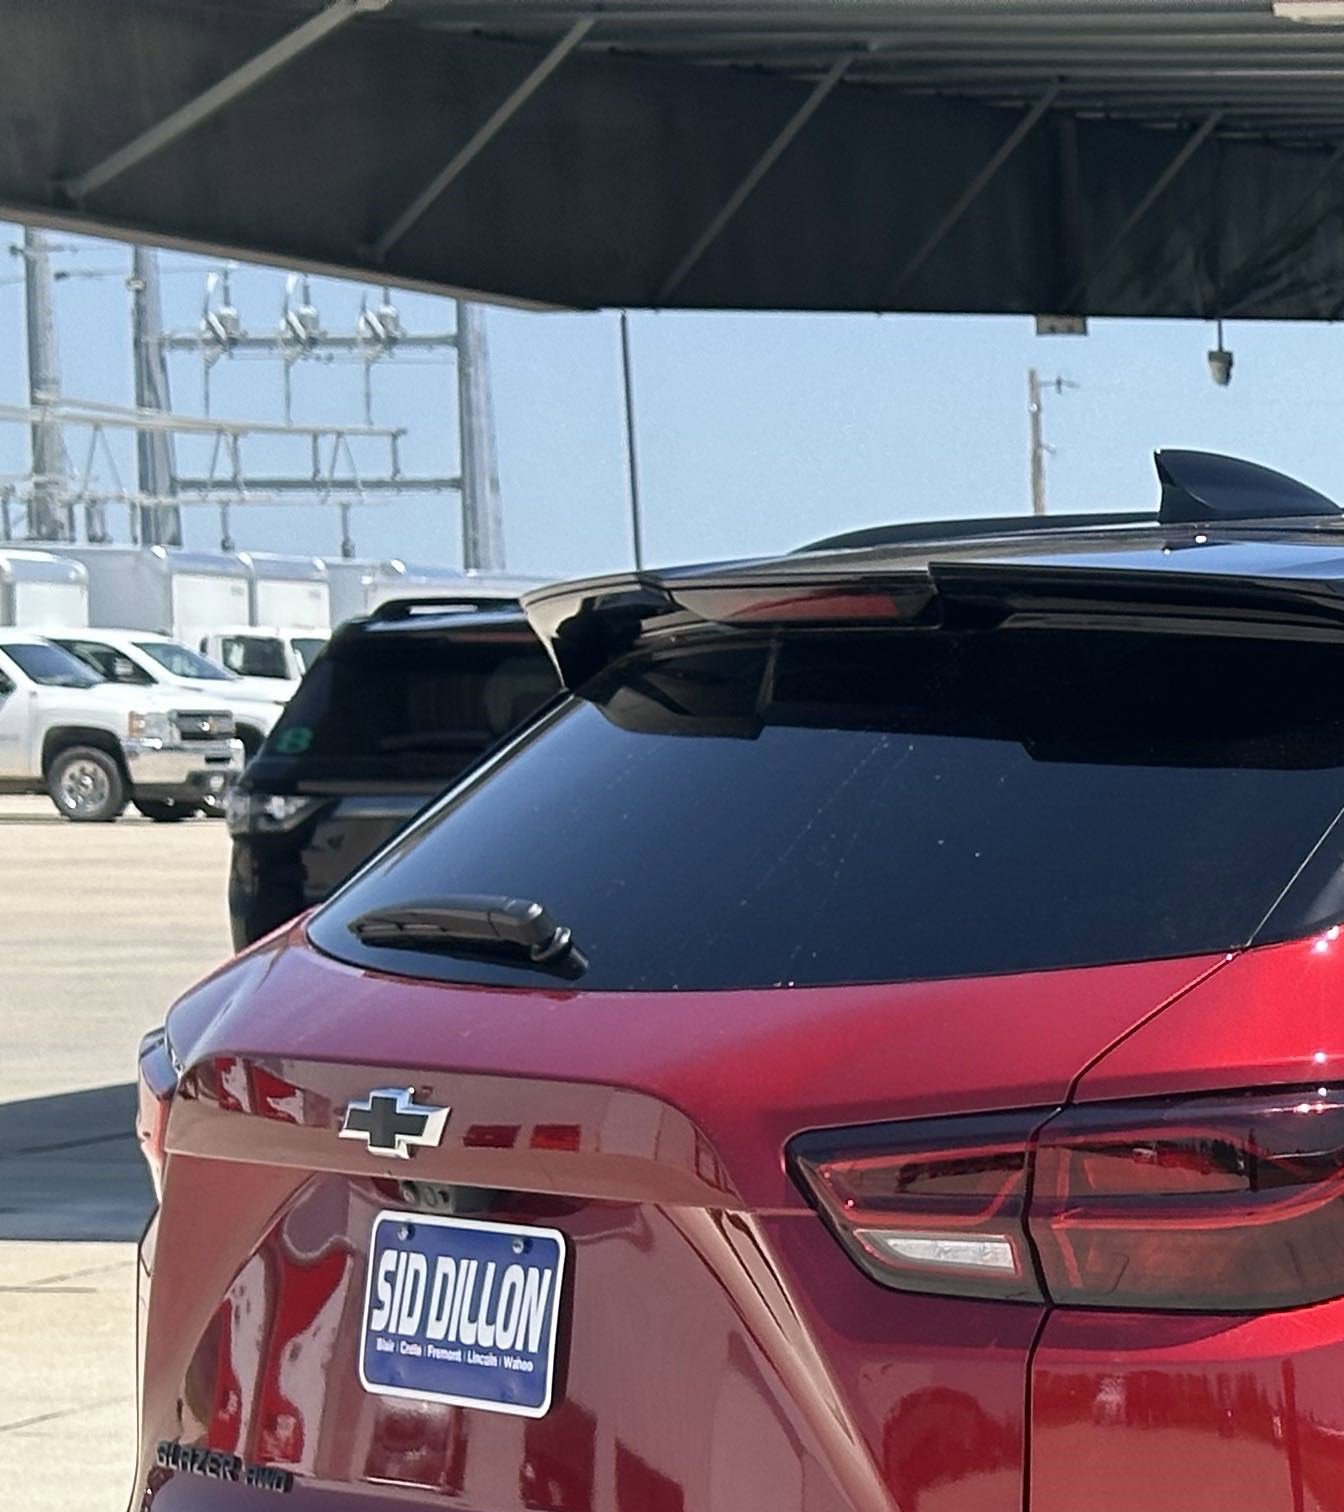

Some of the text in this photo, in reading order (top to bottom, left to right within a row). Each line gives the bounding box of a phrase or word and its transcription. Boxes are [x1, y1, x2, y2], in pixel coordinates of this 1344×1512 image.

[370, 1249, 552, 1353] SID DILLON
[427, 1344, 462, 1363] Fremont
[503, 1353, 534, 1373] Wahoo
[156, 1439, 294, 1494] BLAZER AWD
